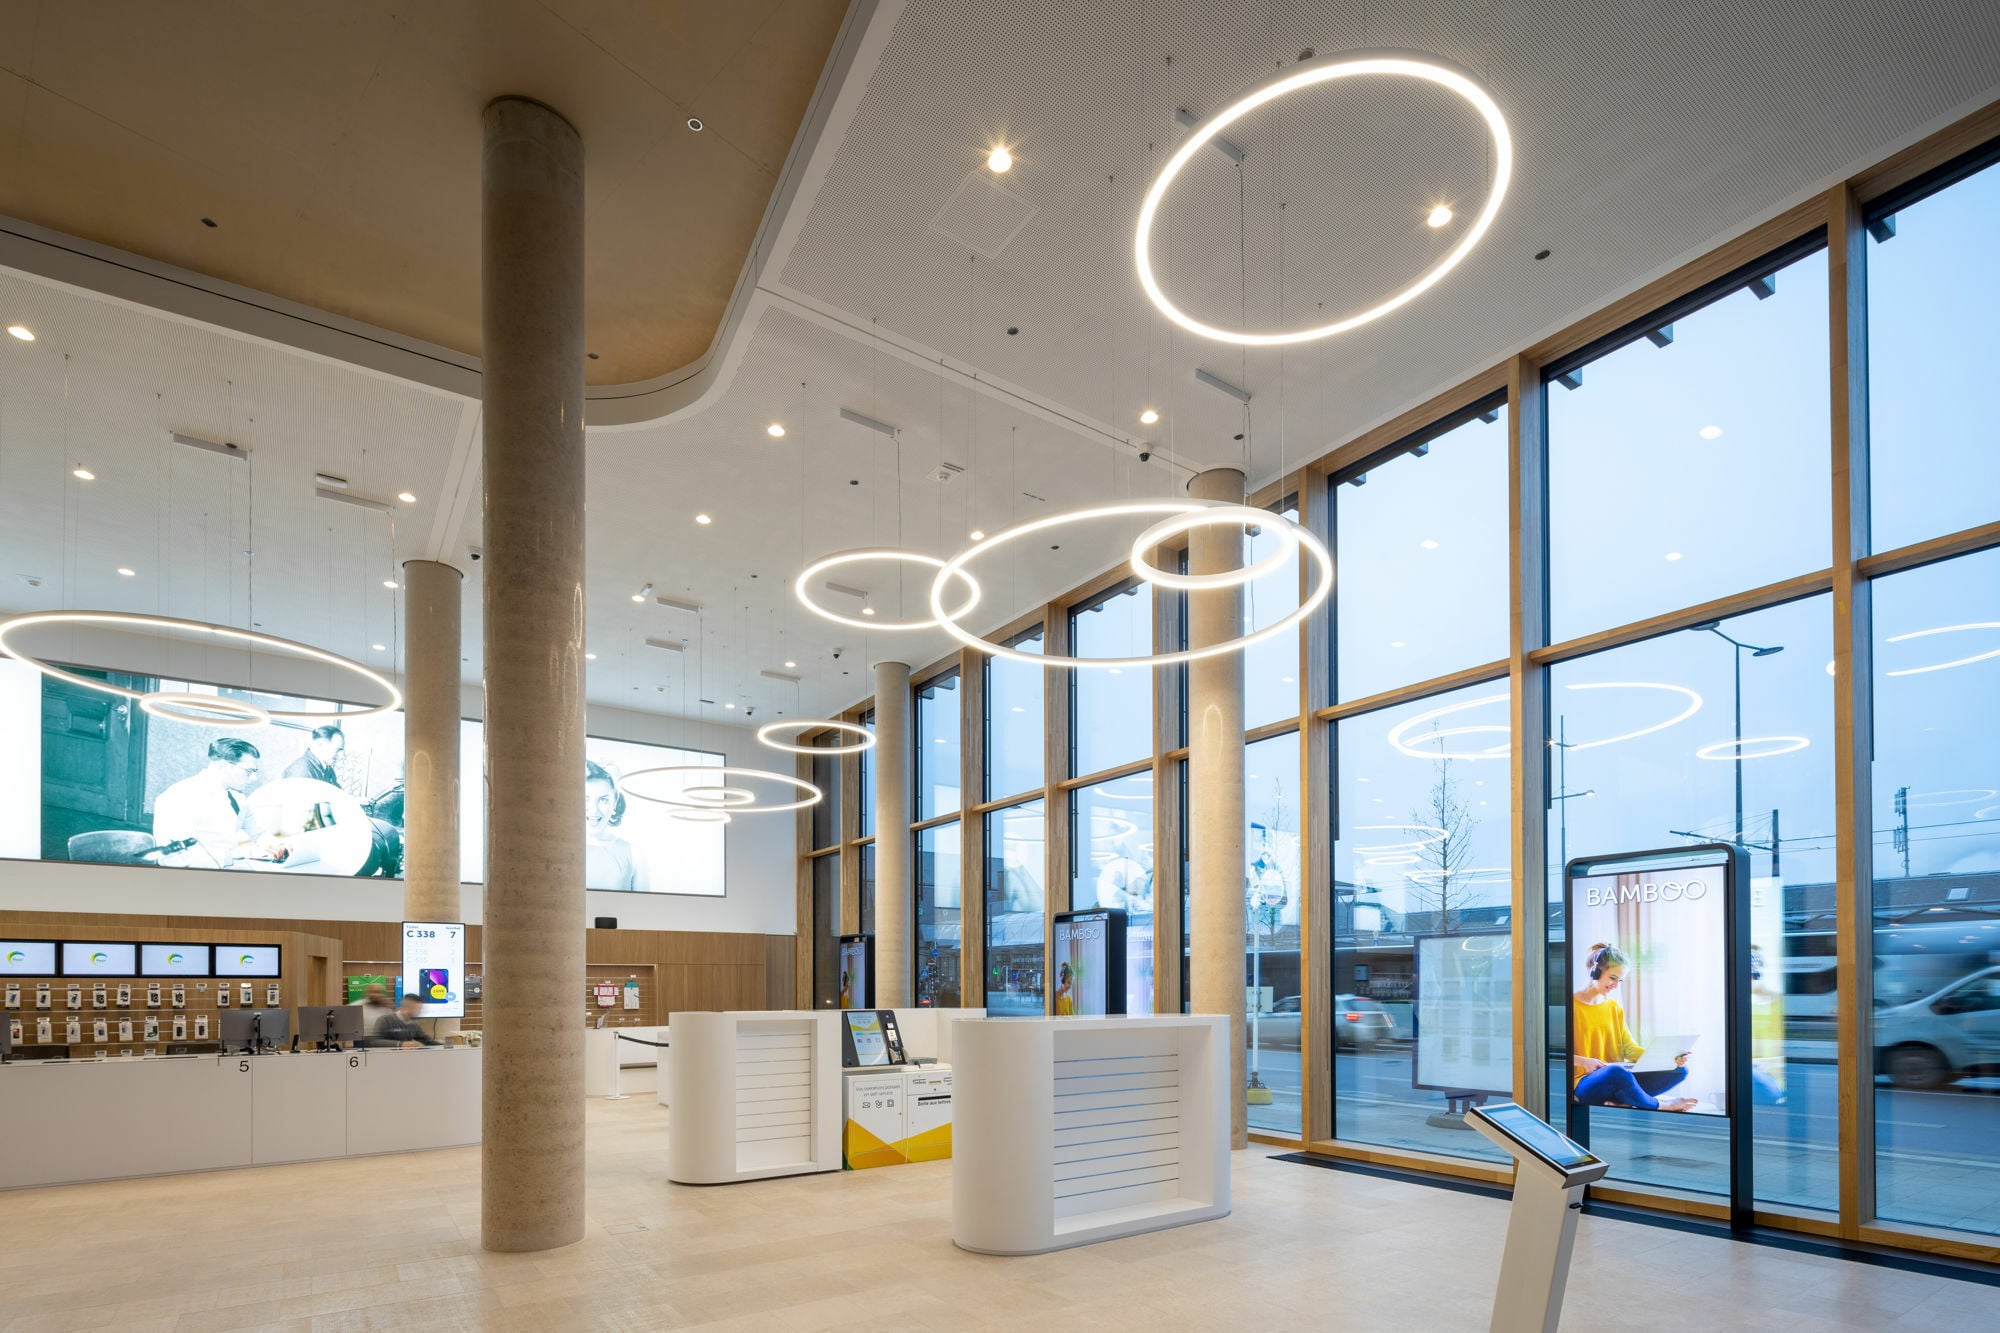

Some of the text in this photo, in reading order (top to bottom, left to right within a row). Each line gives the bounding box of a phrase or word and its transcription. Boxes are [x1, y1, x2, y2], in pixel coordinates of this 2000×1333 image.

[1586, 879, 1707, 906] BAMBOO
[406, 930, 435, 938] C 338
[1059, 927, 1100, 941] BAMBOO
[239, 1060, 249, 1072] 5
[349, 1056, 359, 1067] 6
